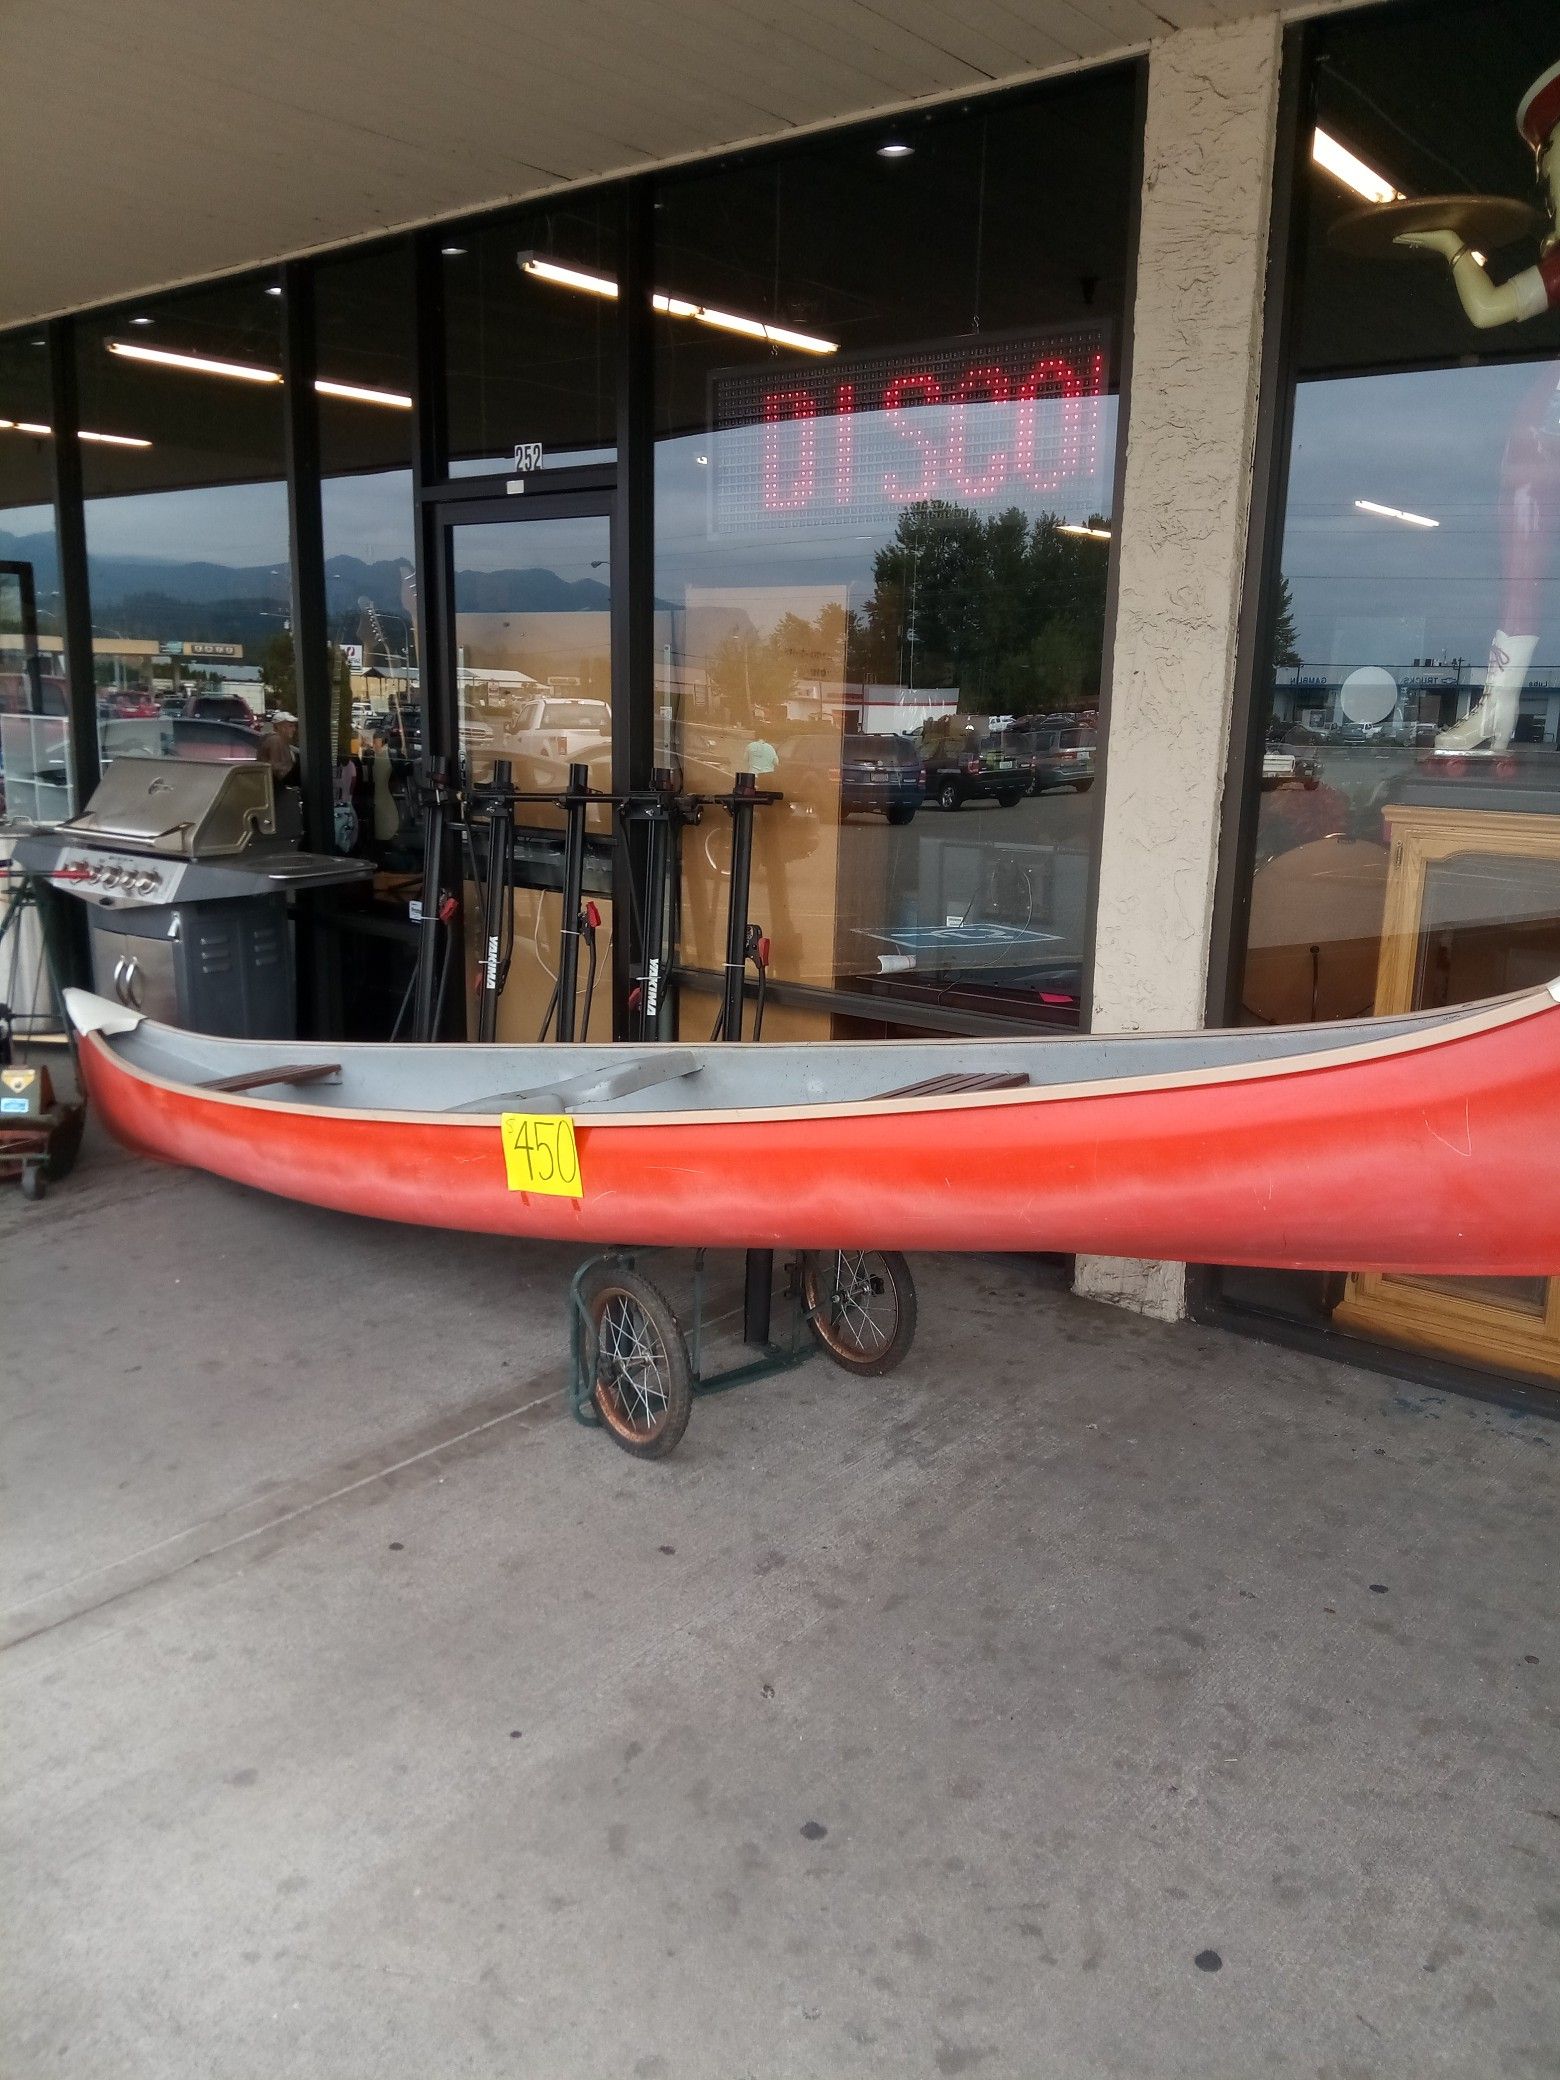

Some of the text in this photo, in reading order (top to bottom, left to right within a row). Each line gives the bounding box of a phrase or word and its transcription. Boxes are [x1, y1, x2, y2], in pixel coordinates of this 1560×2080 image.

[515, 444, 542, 472] 252
[486, 935, 499, 989] YAKIMA
[646, 958, 659, 1016] YAKIMA
